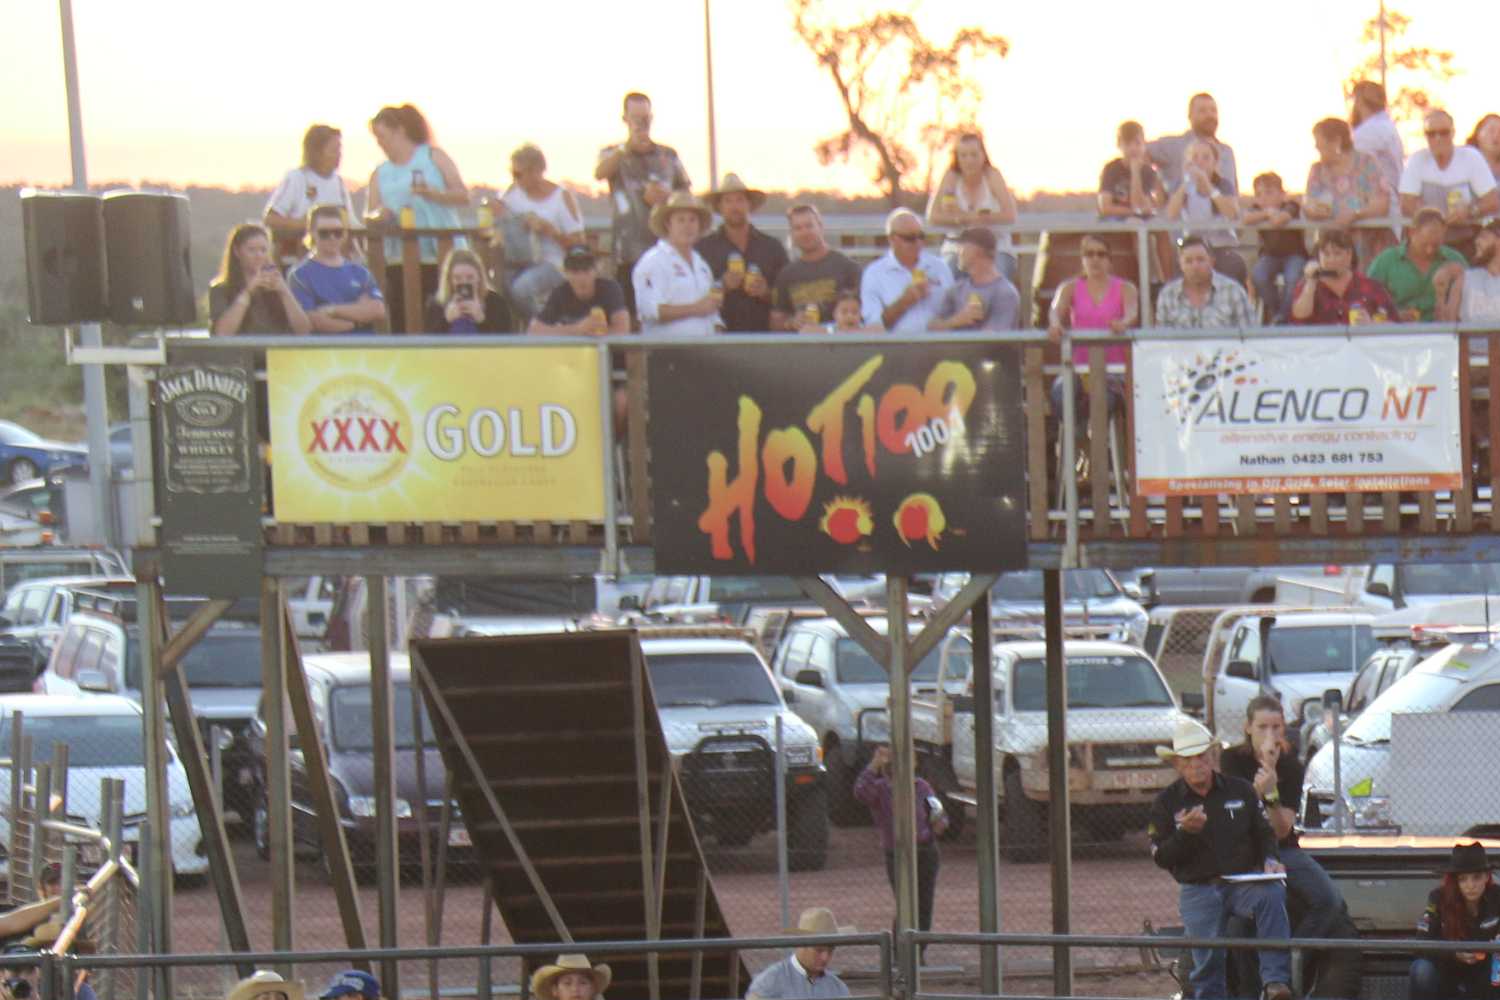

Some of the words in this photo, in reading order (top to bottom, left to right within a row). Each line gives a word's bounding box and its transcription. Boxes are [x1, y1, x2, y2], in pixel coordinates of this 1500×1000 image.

[1194, 387, 1370, 425] ALENCO
[1382, 385, 1438, 421] NT
[306, 416, 409, 455] XXXX
[424, 402, 579, 463] GOLD
[1240, 453, 1285, 465] Nathan
[1292, 453, 1325, 465] 0423
[1359, 451, 1384, 463] 753
